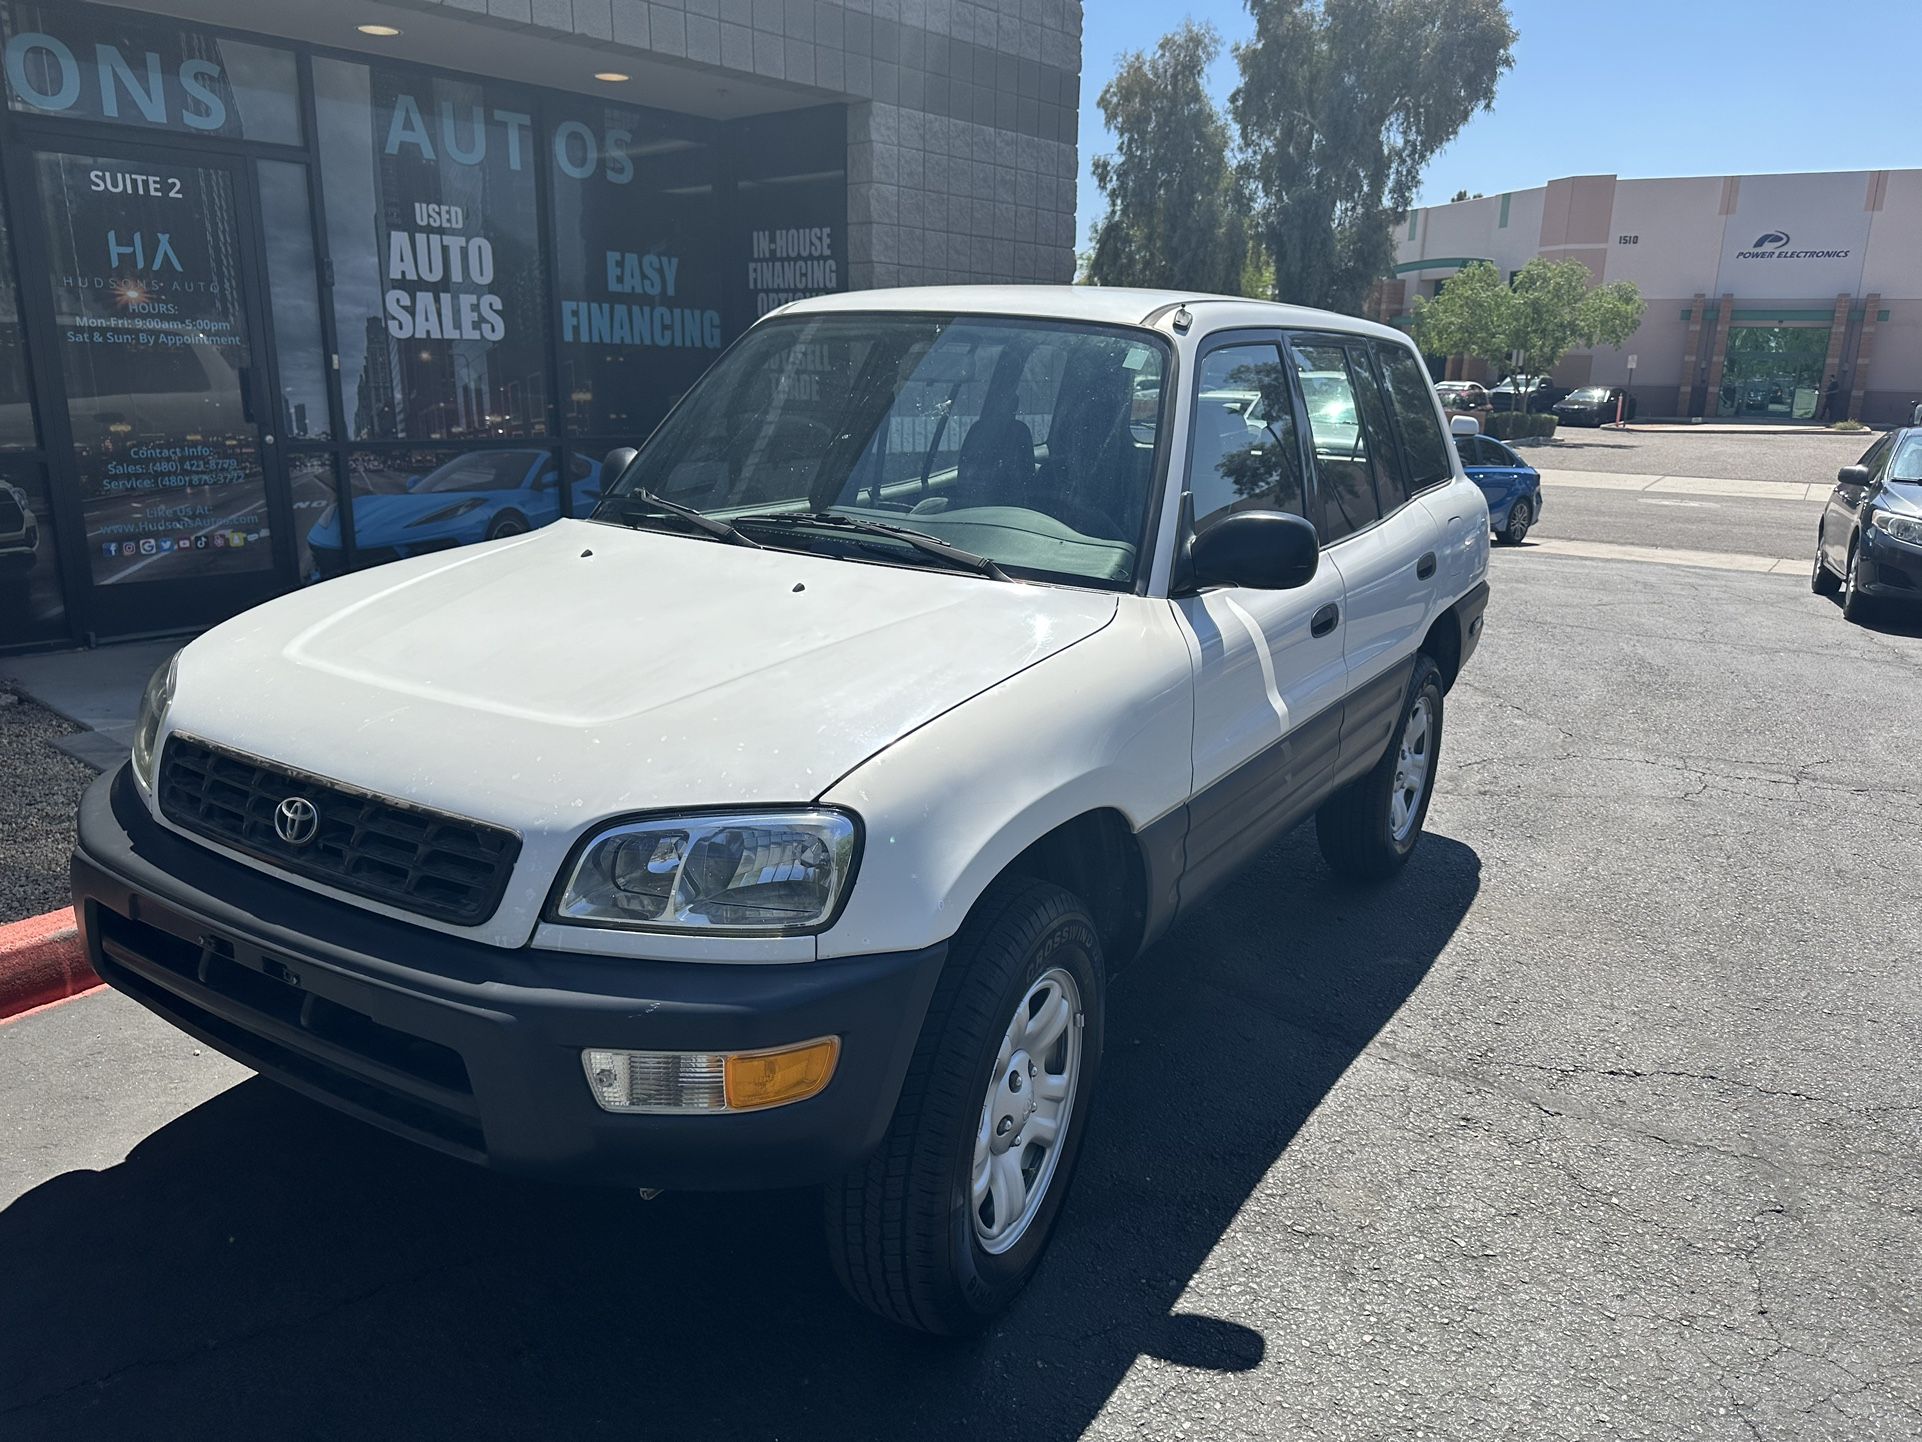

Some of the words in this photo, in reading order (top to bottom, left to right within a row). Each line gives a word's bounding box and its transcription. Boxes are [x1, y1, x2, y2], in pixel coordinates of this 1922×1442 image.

[4, 32, 226, 130] ONS
[384, 94, 635, 184] AUTOS
[89, 170, 162, 197] SUITE
[168, 178, 183, 198] 2
[414, 202, 463, 229] USED
[752, 227, 832, 259] IN-HOUSE
[1619, 235, 1639, 245] 1510
[389, 230, 494, 285] AUTO
[1736, 251, 1775, 259] POWER
[1776, 250, 1850, 259] ELECTRONICS
[63, 276, 160, 291] HUDSONS
[606, 251, 679, 297] EASY
[748, 259, 837, 289] FINANCING
[129, 303, 178, 315] HOURS:
[384, 289, 506, 342] SALES
[75, 316, 132, 328] Mon-Fri:
[135, 318, 230, 332] 9:00am-5:00pm
[561, 300, 721, 349] FINANCING
[67, 331, 89, 343] Sat
[93, 333, 103, 343] &
[107, 332, 135, 344] Sun:
[139, 333, 155, 346] By
[158, 334, 241, 347] Appointment
[130, 447, 182, 459] Contact
[185, 446, 213, 457] Info:
[107, 462, 146, 475] Sales:
[149, 461, 180, 474] (480)
[103, 476, 155, 490] Service:
[158, 475, 189, 488] (480)
